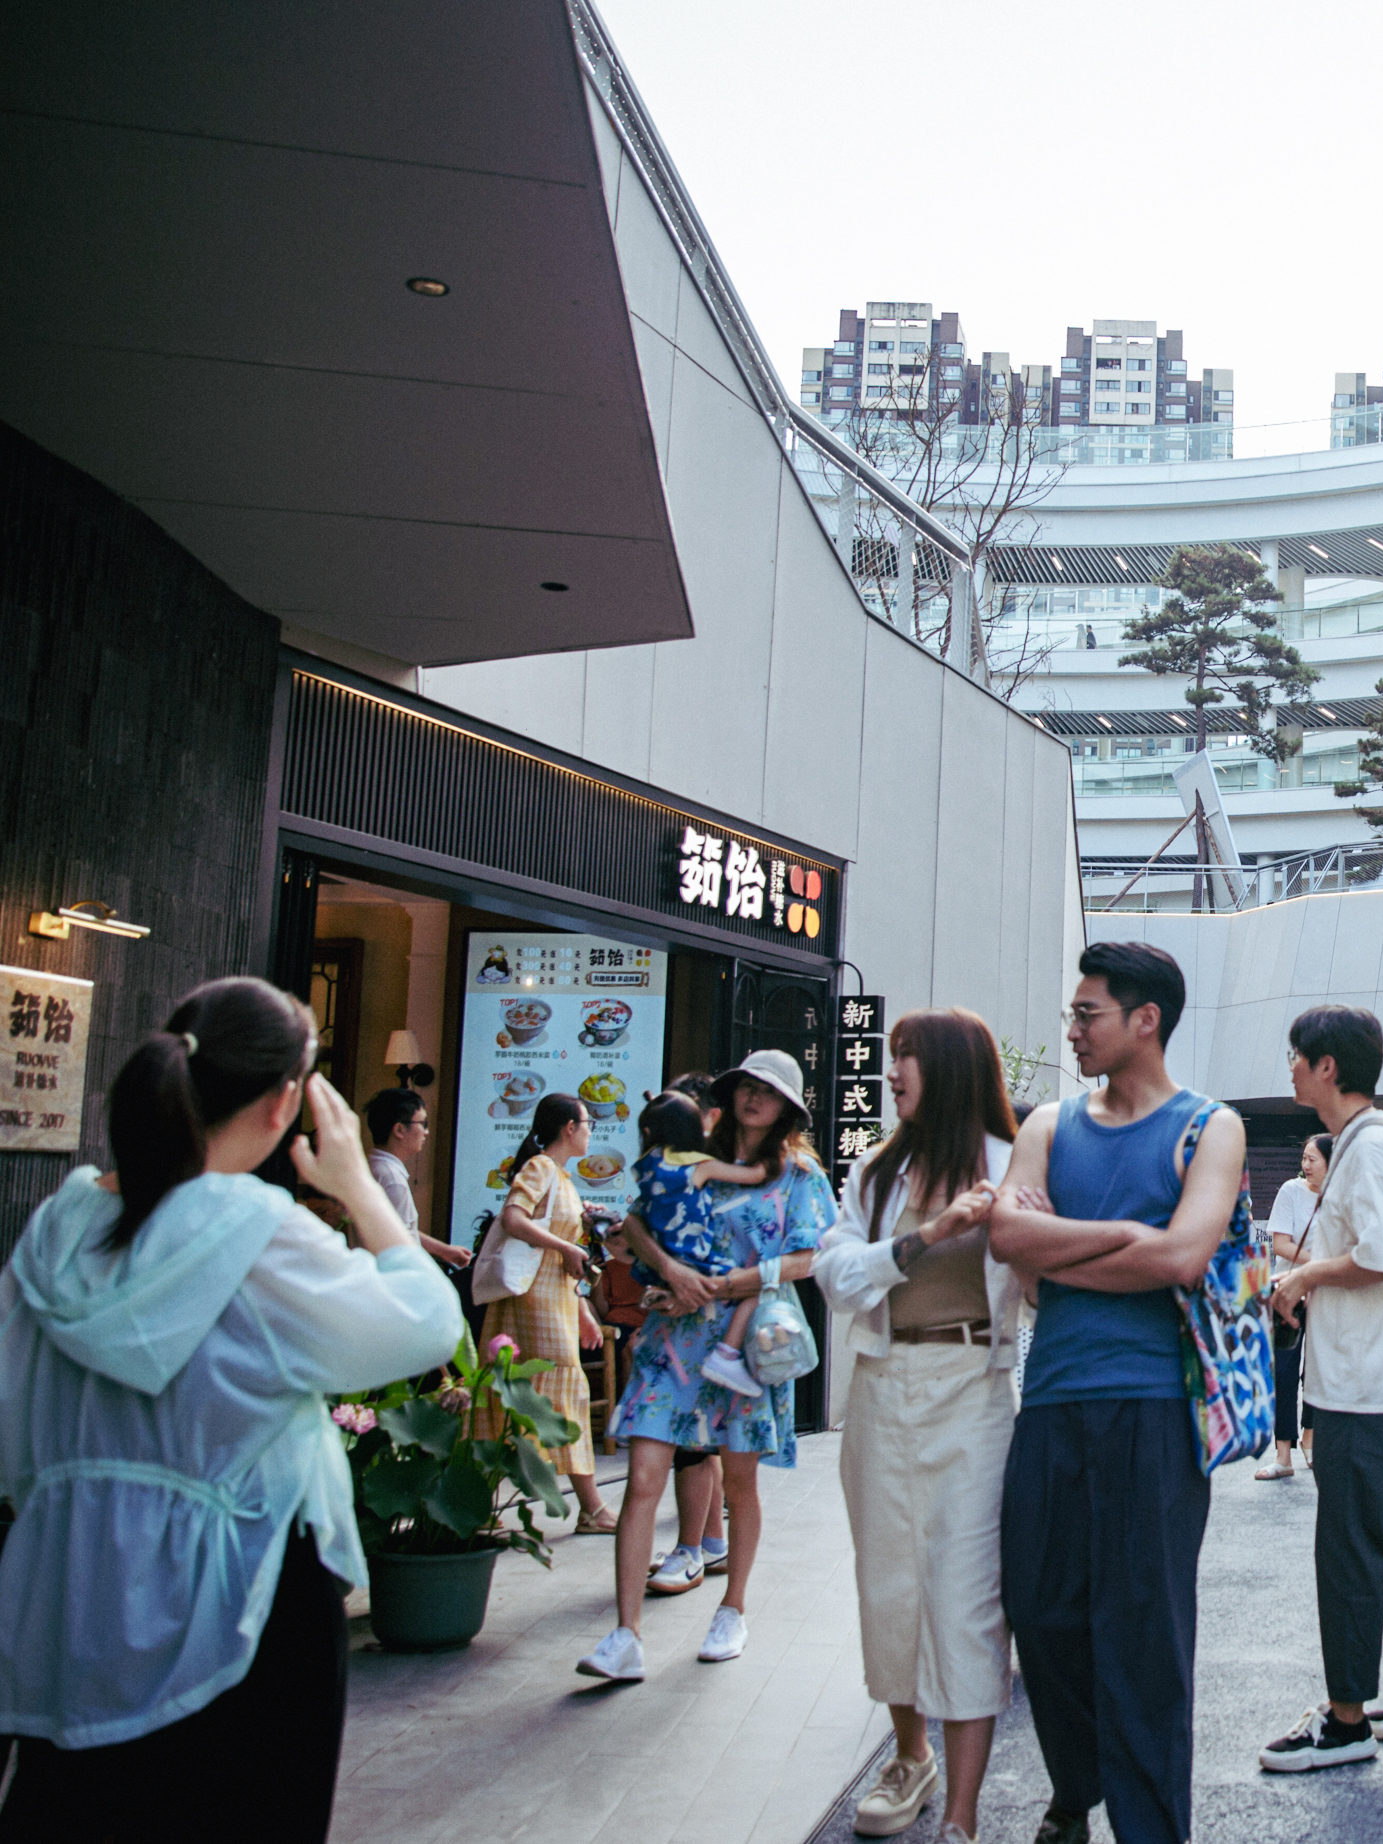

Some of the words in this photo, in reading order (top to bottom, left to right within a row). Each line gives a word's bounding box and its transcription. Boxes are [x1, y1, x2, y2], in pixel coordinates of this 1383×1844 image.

[500, 998, 519, 1007] TOP1
[492, 1072, 512, 1080] TOP3
[39, 1113, 66, 1129] 2017
[1255, 1235, 1273, 1243] KING
